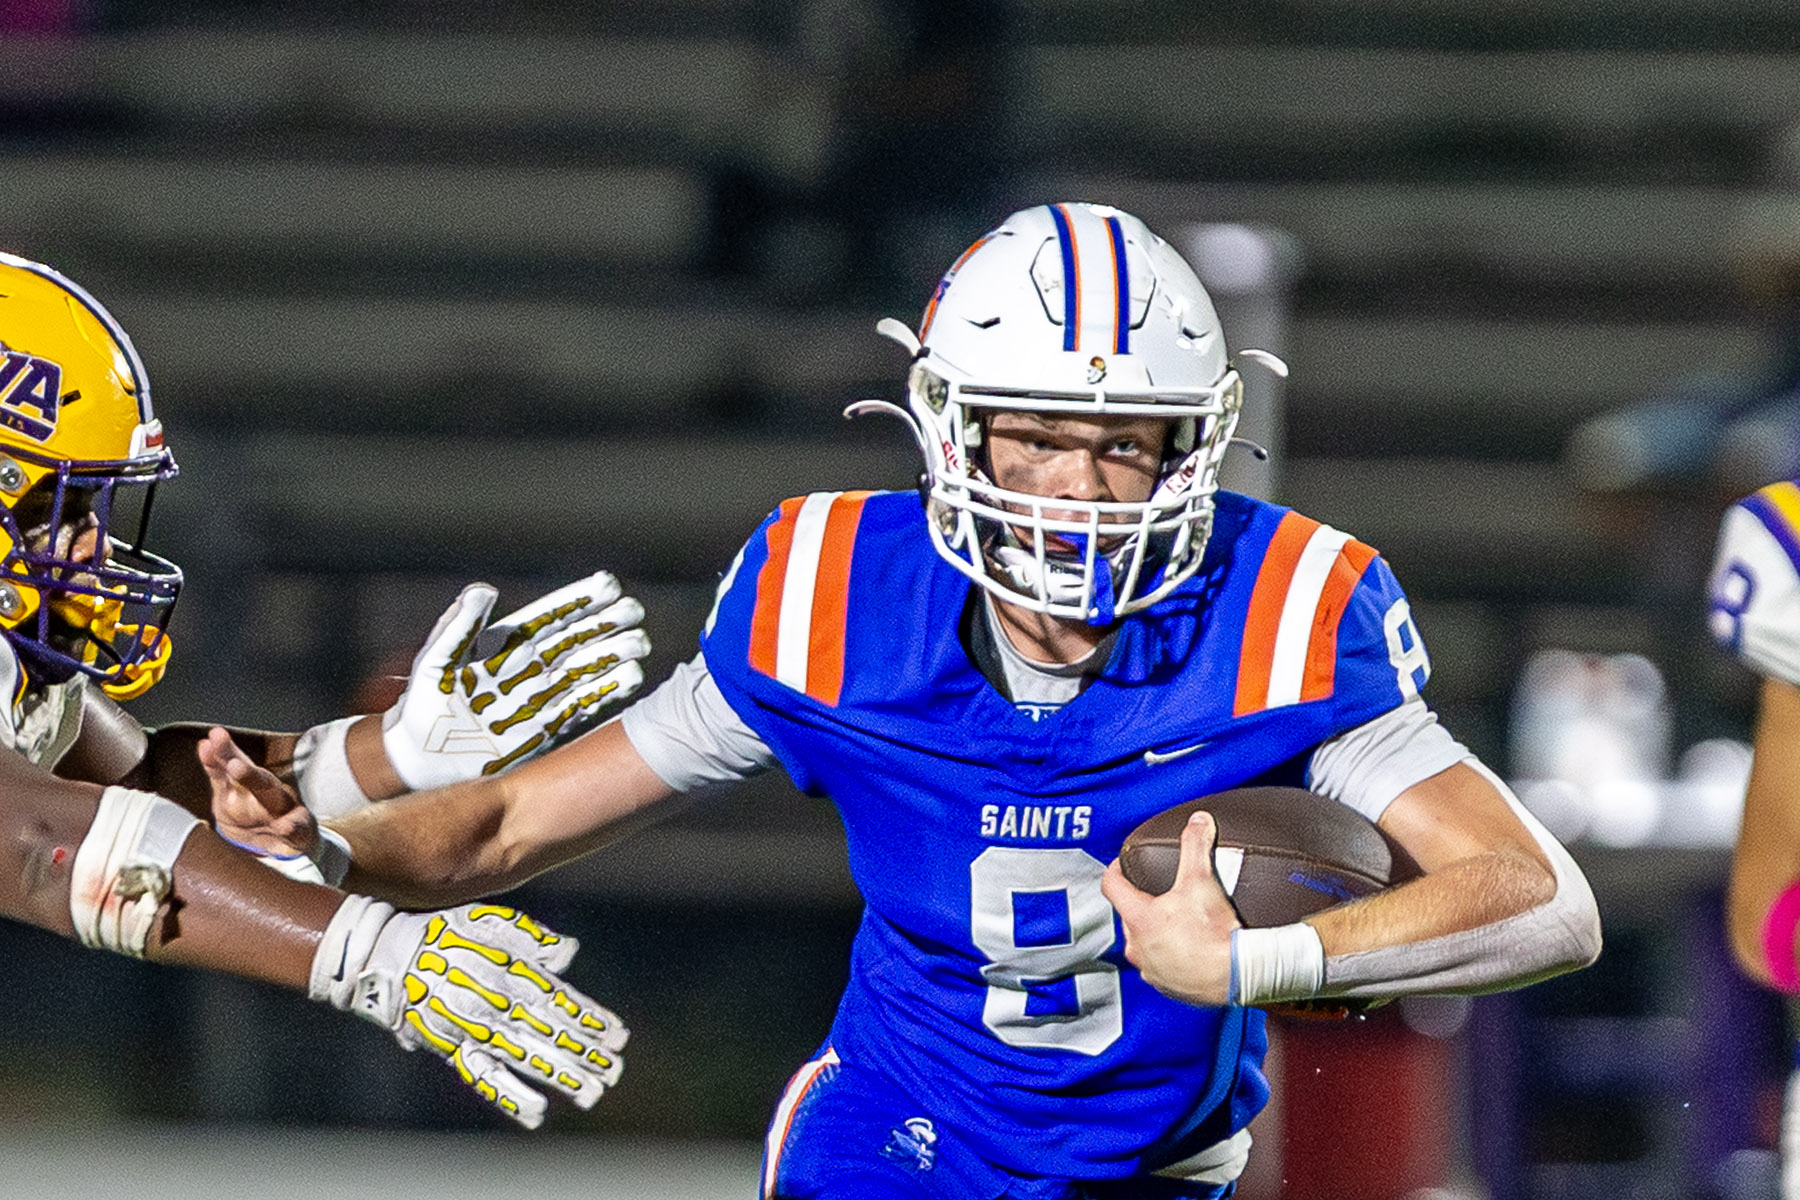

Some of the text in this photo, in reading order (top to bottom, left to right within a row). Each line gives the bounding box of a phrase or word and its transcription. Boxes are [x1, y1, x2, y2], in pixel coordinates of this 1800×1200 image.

[1383, 597, 1432, 703] 8
[981, 804, 1092, 839] SAINTS
[970, 847, 1123, 1057] 8
